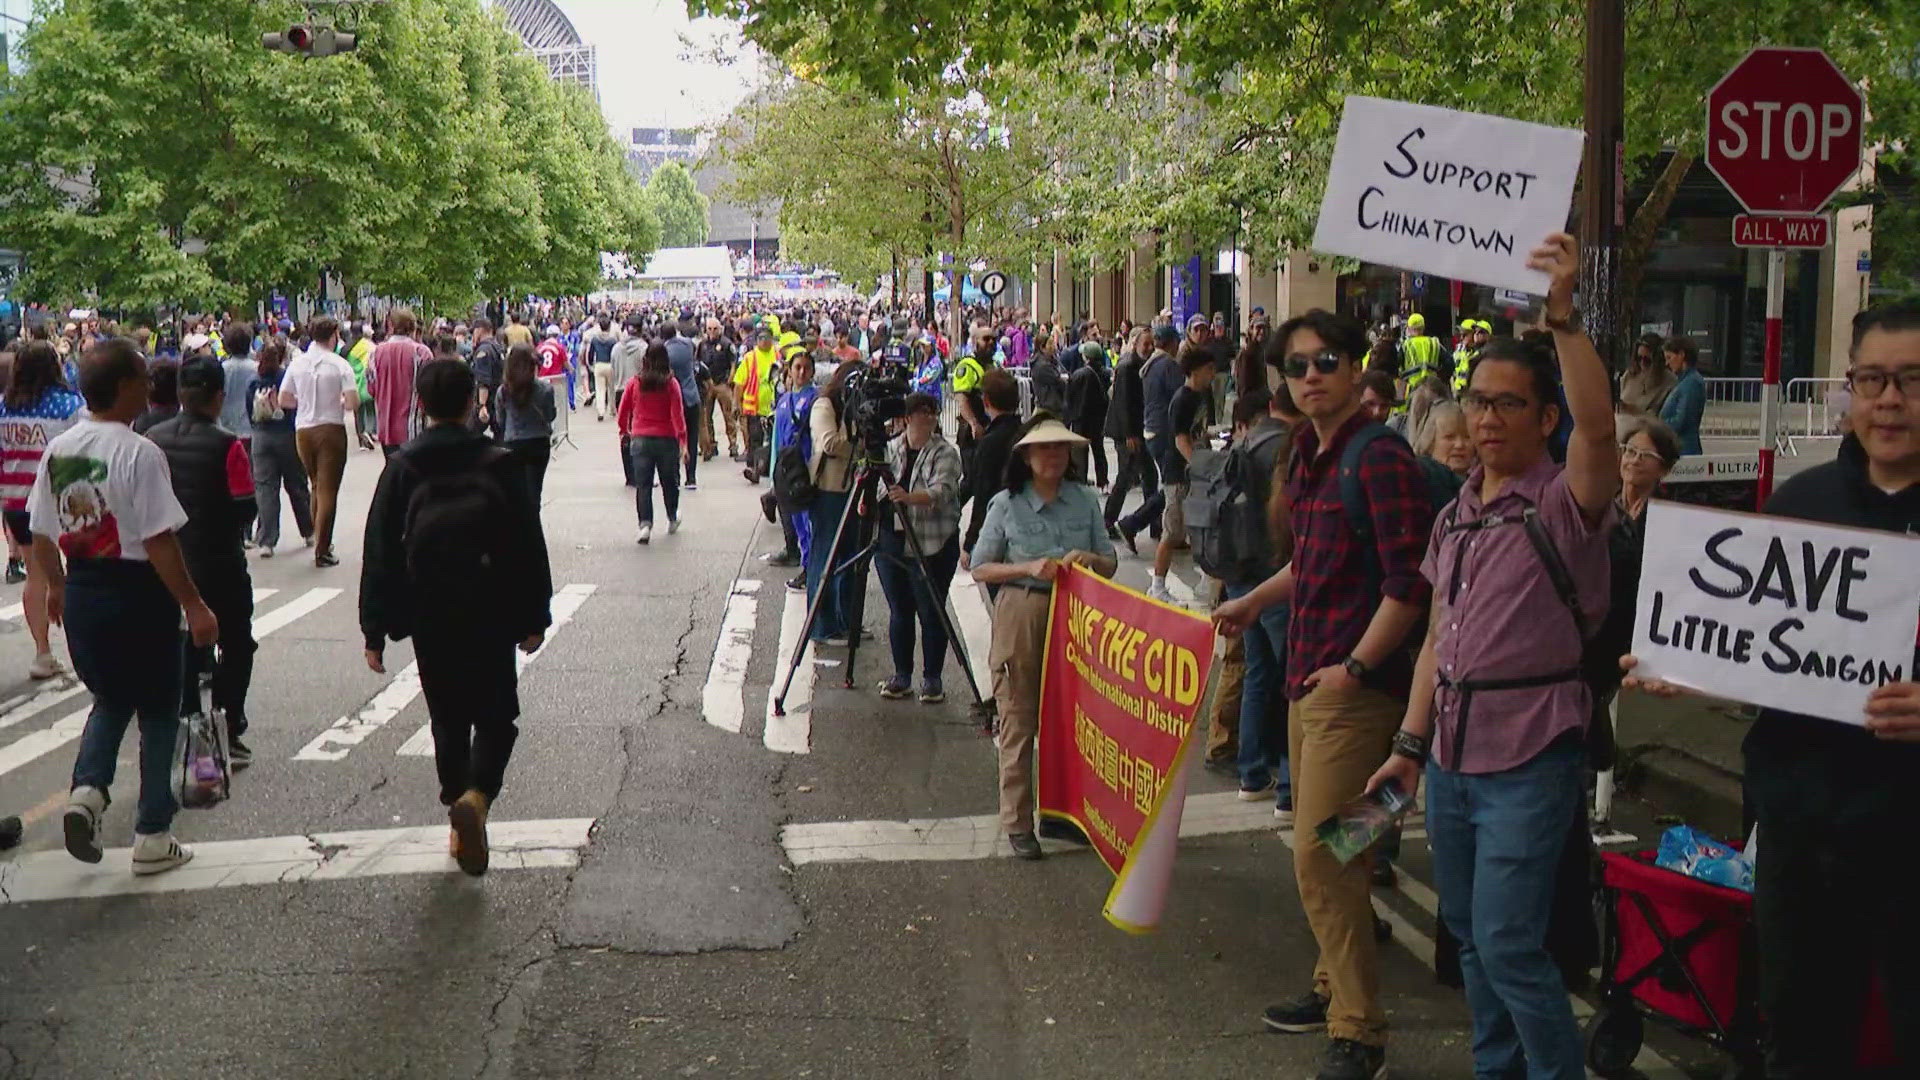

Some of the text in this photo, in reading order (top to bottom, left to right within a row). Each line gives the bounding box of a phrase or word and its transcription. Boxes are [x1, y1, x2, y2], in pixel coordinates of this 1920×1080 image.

[1718, 100, 1853, 161] STOP
[1383, 127, 1537, 200] SUPPORT
[1357, 186, 1514, 256] CHINATOWN
[1742, 222, 1820, 241] ALL WAY
[542, 351, 554, 369] 8
[4, 422, 49, 446] USA
[1717, 462, 1759, 474] ULTRA
[1688, 527, 1870, 623] SAVE
[1098, 616, 1149, 683] THE
[1143, 638, 1201, 707] CID
[1648, 590, 1903, 688] LITTLE SAIGON
